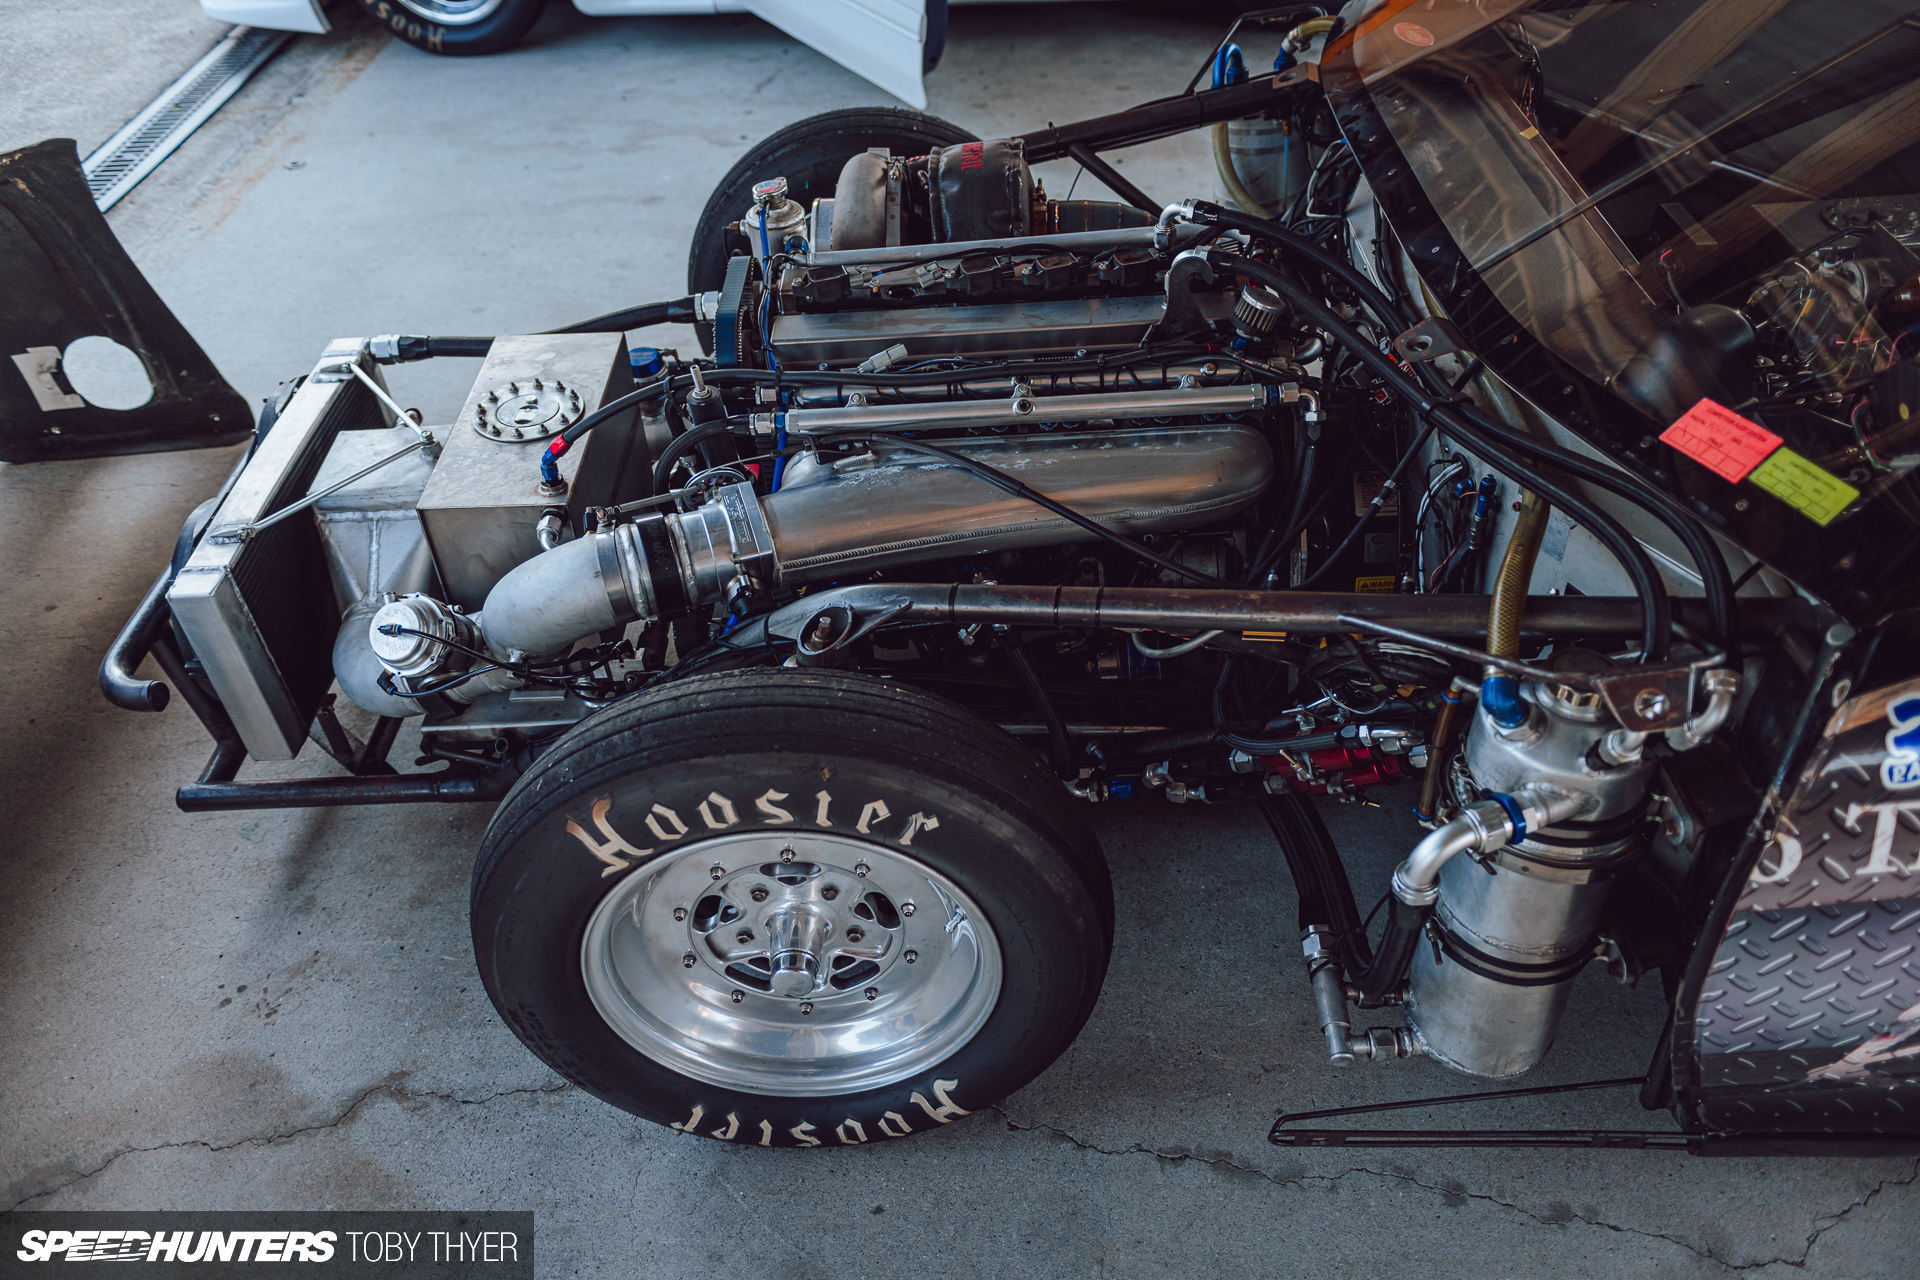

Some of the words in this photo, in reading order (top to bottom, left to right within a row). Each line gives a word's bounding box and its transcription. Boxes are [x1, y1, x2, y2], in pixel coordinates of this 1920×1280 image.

[365, 0, 447, 52] Hoos
[1706, 407, 1736, 425] COMPETITOR
[1732, 421, 1750, 433] AUDIT
[1745, 428, 1768, 443] SYSTEM
[565, 764, 941, 879] Hoosier
[669, 1078, 980, 1149] Hoosier
